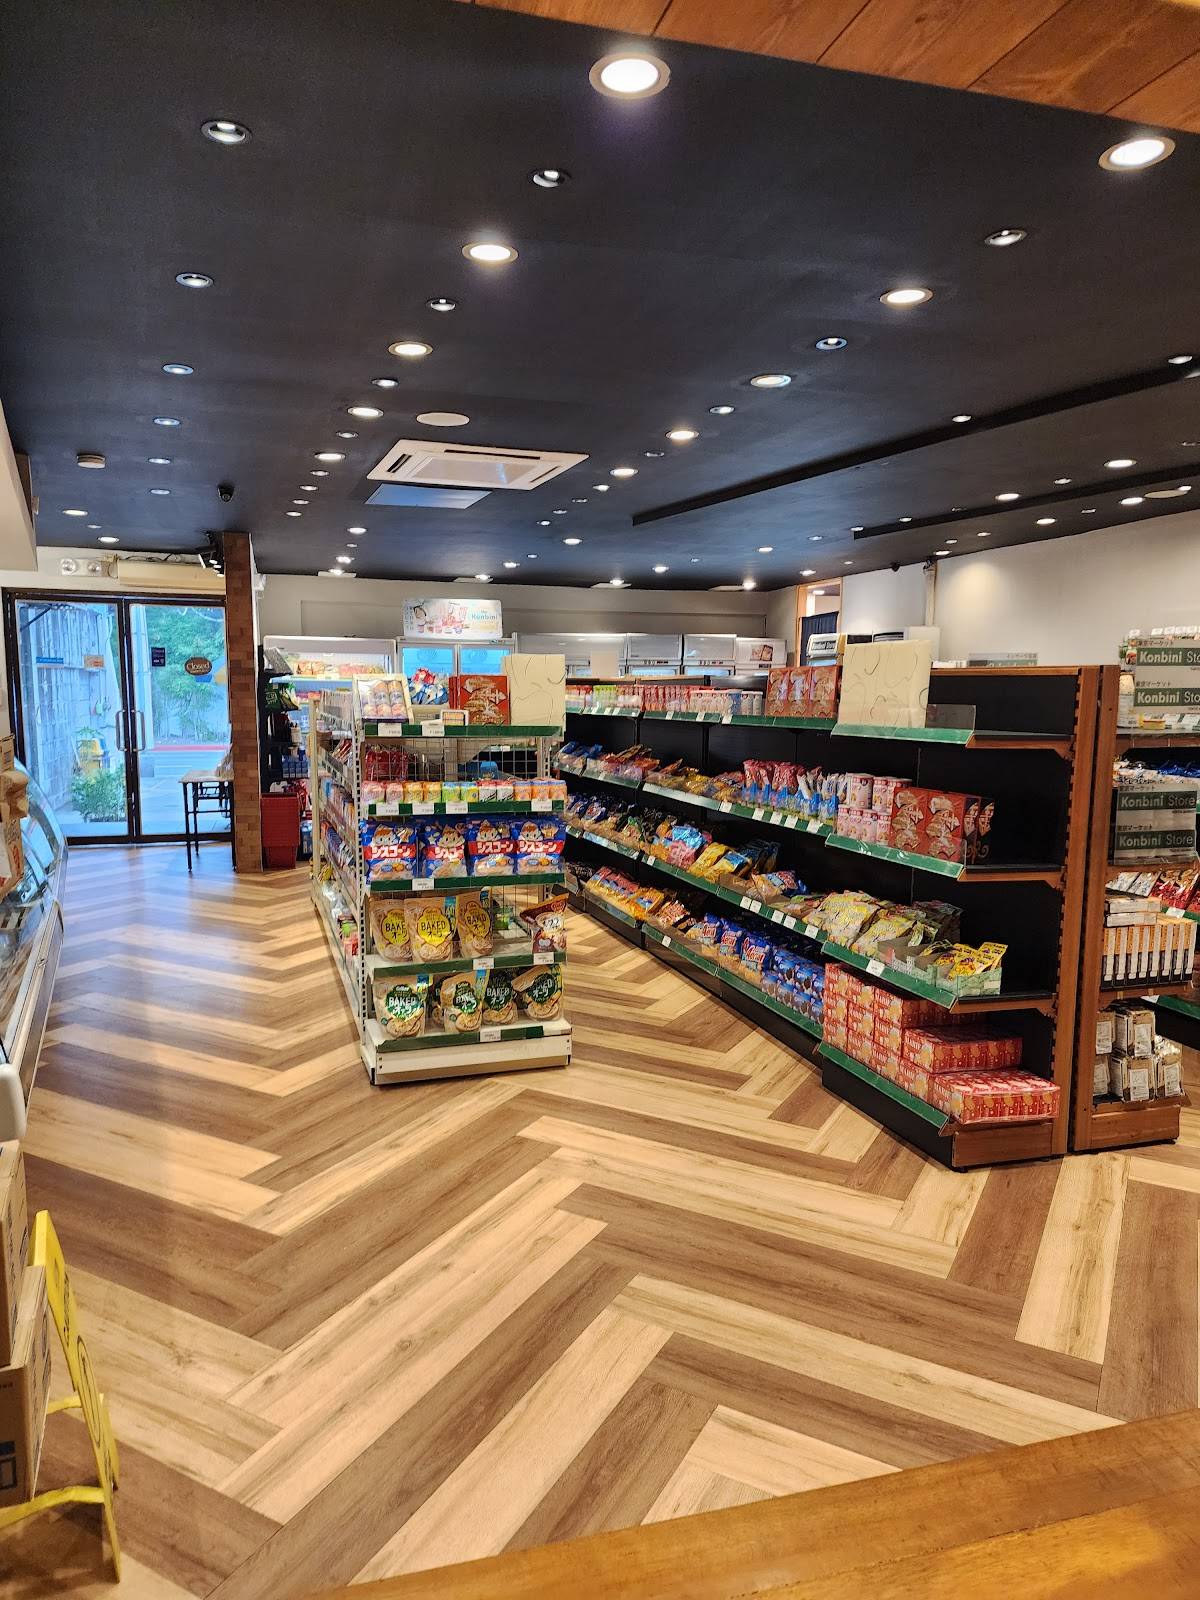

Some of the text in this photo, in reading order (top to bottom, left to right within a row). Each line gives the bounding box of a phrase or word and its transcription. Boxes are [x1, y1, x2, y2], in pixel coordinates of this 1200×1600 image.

[1139, 651, 1183, 663] Konbini
[186, 661, 210, 670] Closed
[1137, 691, 1180, 704] Konbini
[1120, 794, 1196, 808] Konbini Store
[519, 840, 558, 853] シスコーン
[1119, 833, 1194, 847] Konbini Store
[371, 844, 412, 859] シスコーン
[477, 841, 514, 854] シスコーン
[385, 922, 406, 932] BAKE
[420, 920, 446, 931] BAKED
[388, 996, 417, 1008] BAKED
